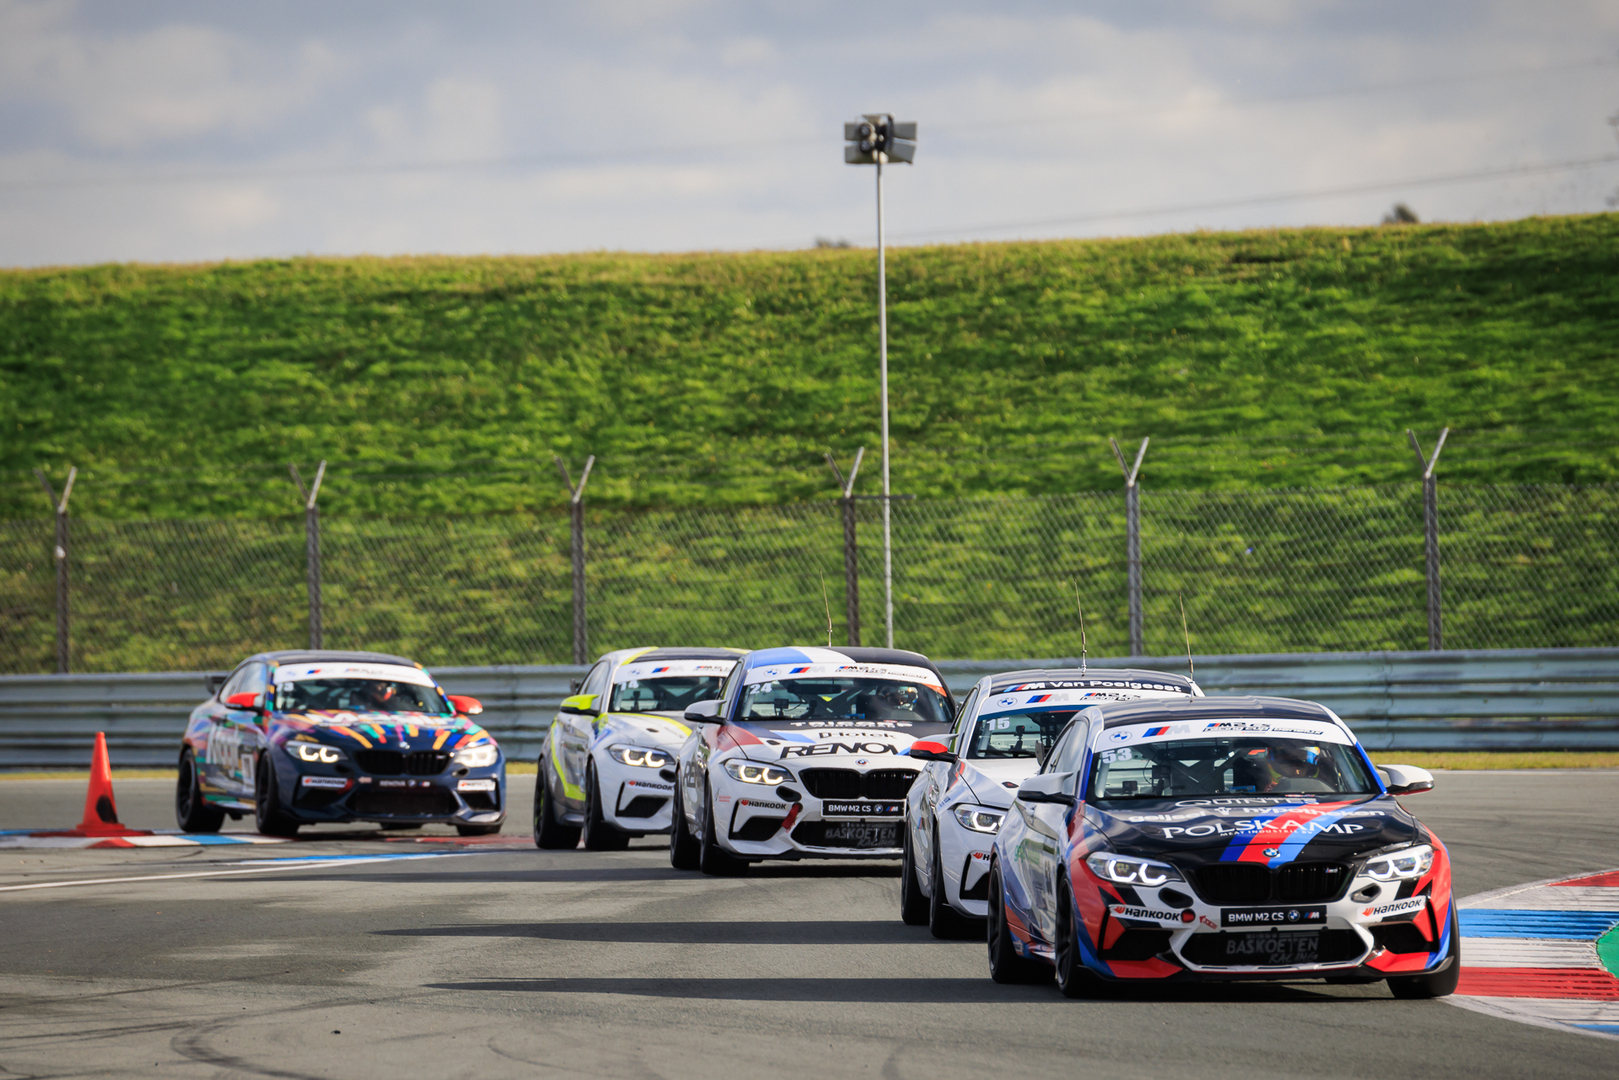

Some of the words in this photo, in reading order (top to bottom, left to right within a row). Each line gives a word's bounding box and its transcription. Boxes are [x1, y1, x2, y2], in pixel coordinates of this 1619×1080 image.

[749, 682, 773, 695] 24
[1089, 680, 1182, 693] Poelgeest
[986, 717, 1011, 731] 15
[1102, 747, 1133, 764] 53
[828, 804, 848, 812] BMW
[848, 804, 861, 812] M2
[861, 804, 872, 812] CS
[1242, 806, 1386, 817] hypotheken
[1162, 819, 1364, 839] POLSKAMP
[1228, 913, 1254, 922] BMW
[1255, 912, 1270, 922] M2
[1271, 912, 1285, 921] CS
[1226, 937, 1320, 955] BASKOETEN
[1268, 952, 1319, 965] RACING
